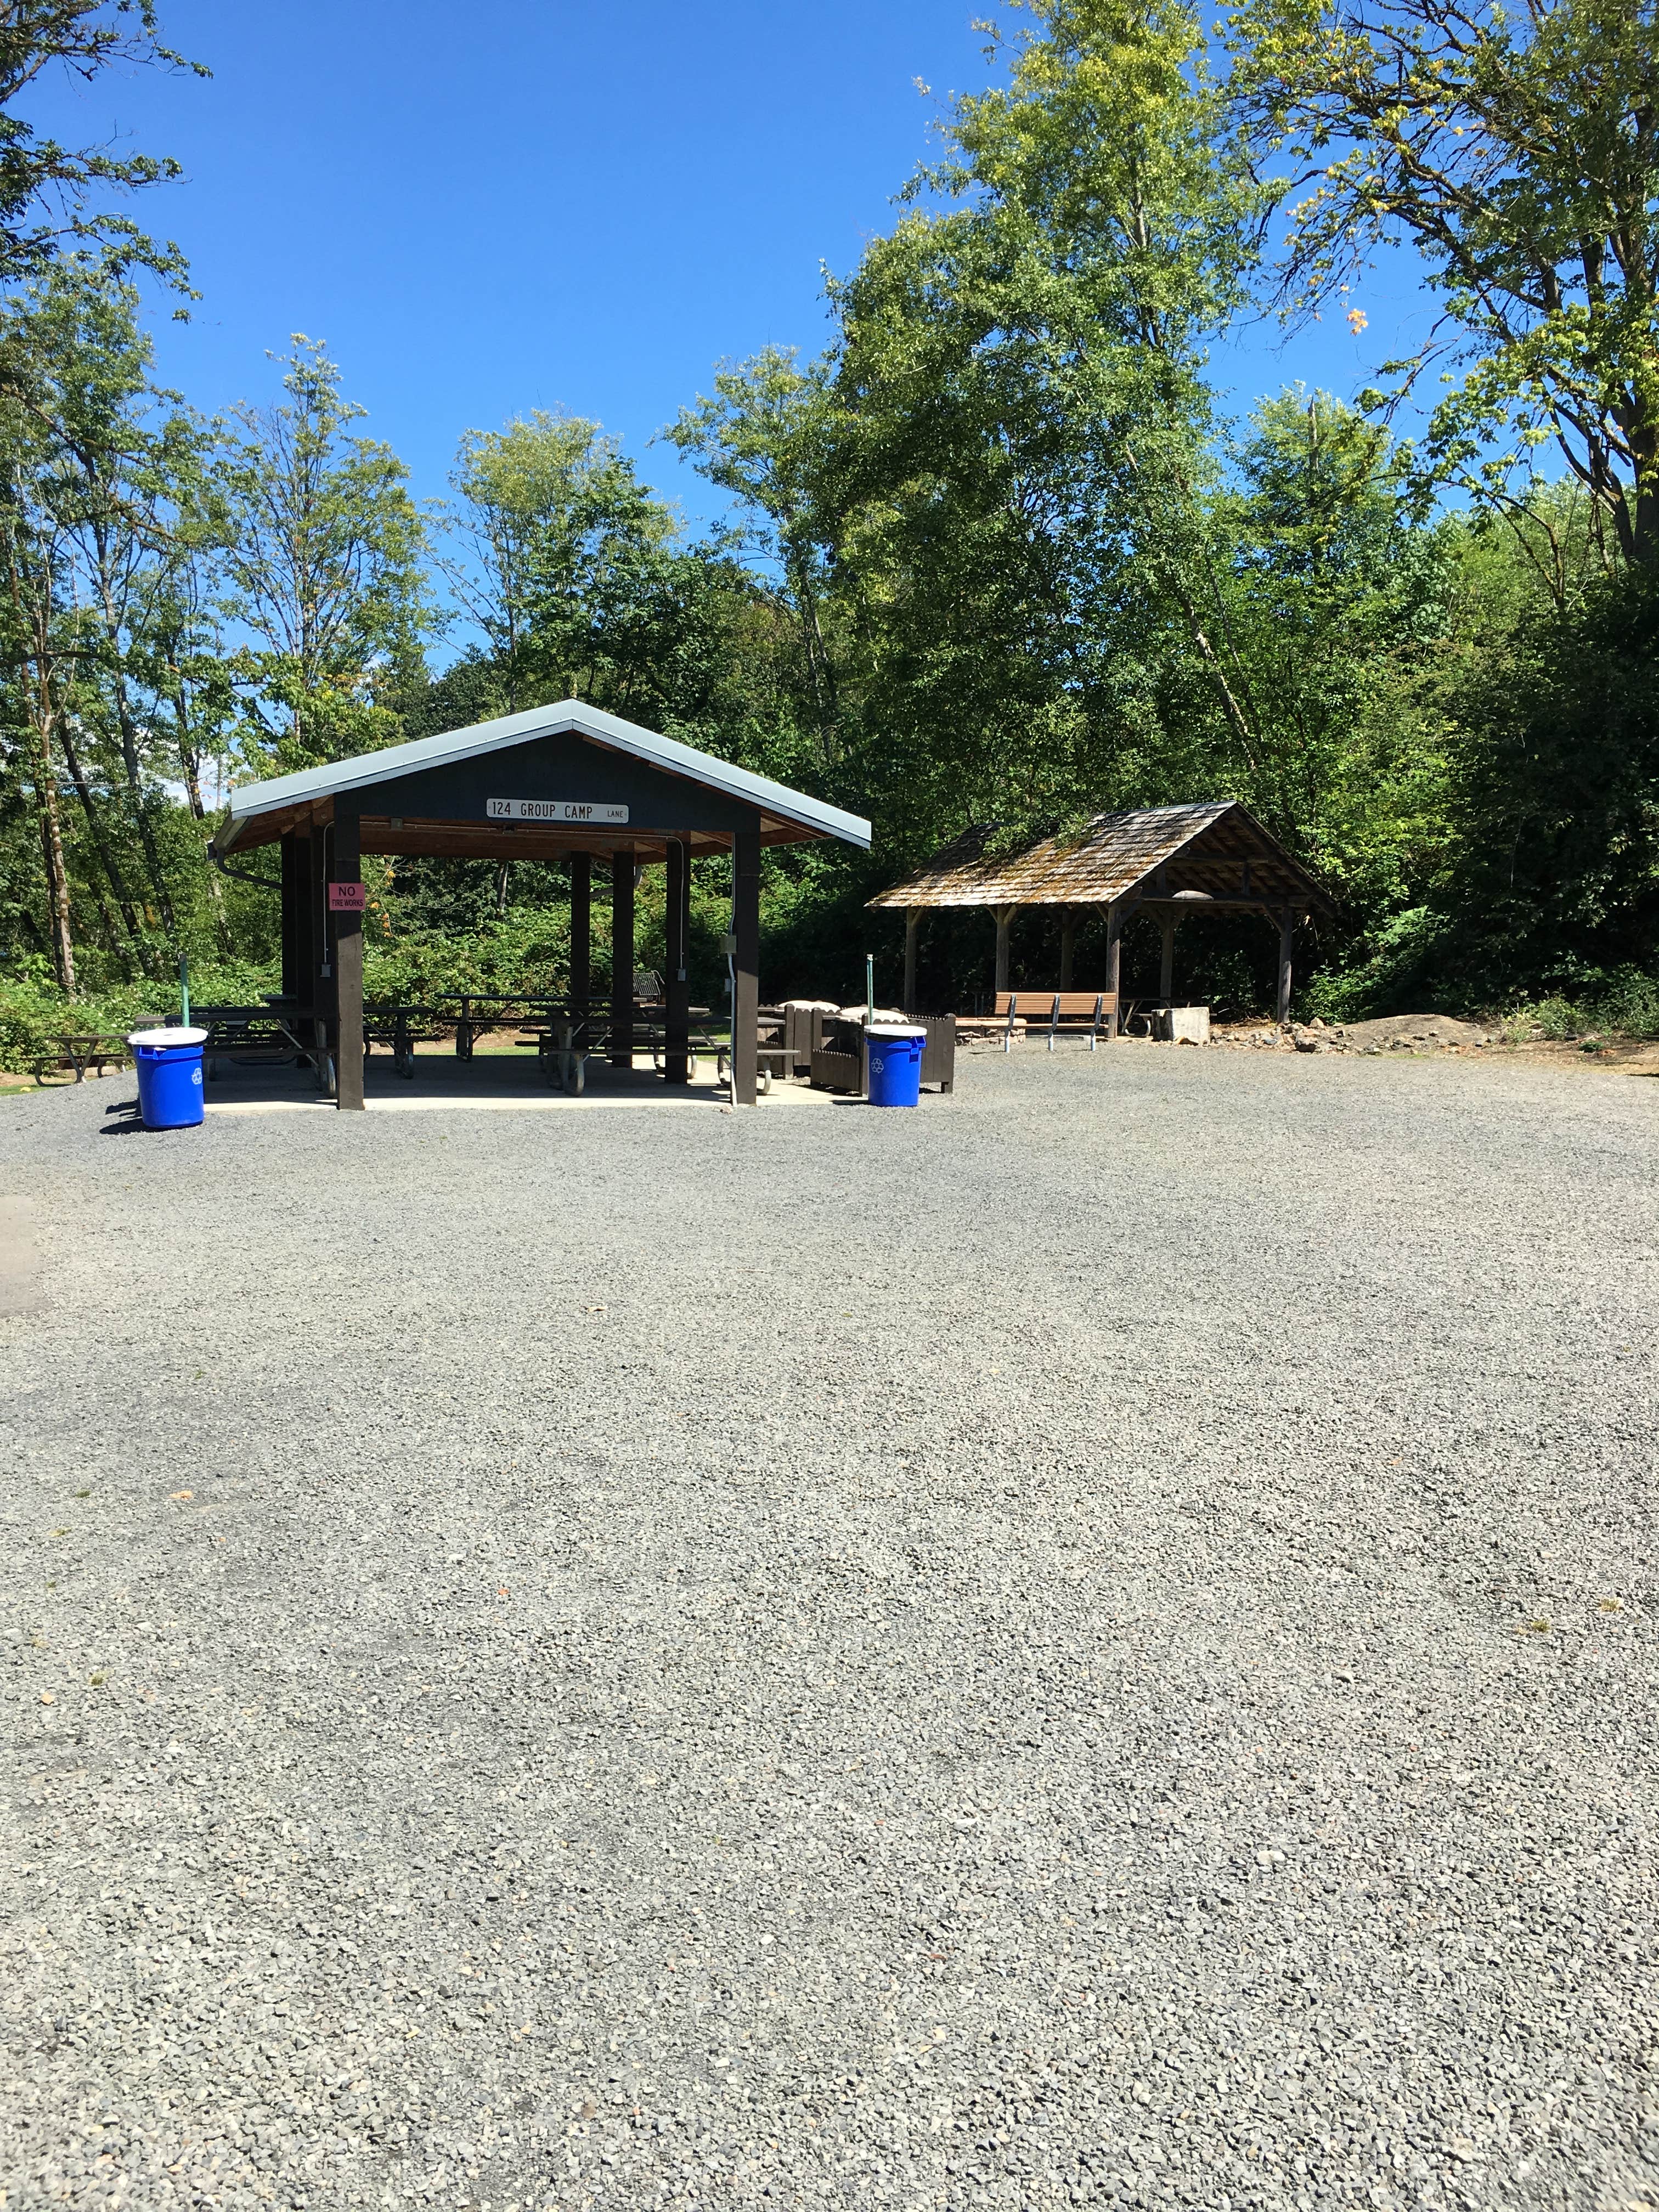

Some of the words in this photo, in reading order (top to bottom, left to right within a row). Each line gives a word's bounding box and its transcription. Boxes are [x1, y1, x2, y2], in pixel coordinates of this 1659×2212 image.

[493, 802, 511, 815] 124
[521, 803, 556, 817] GROUP
[565, 805, 592, 819] CAMP
[338, 887, 356, 896] NO
